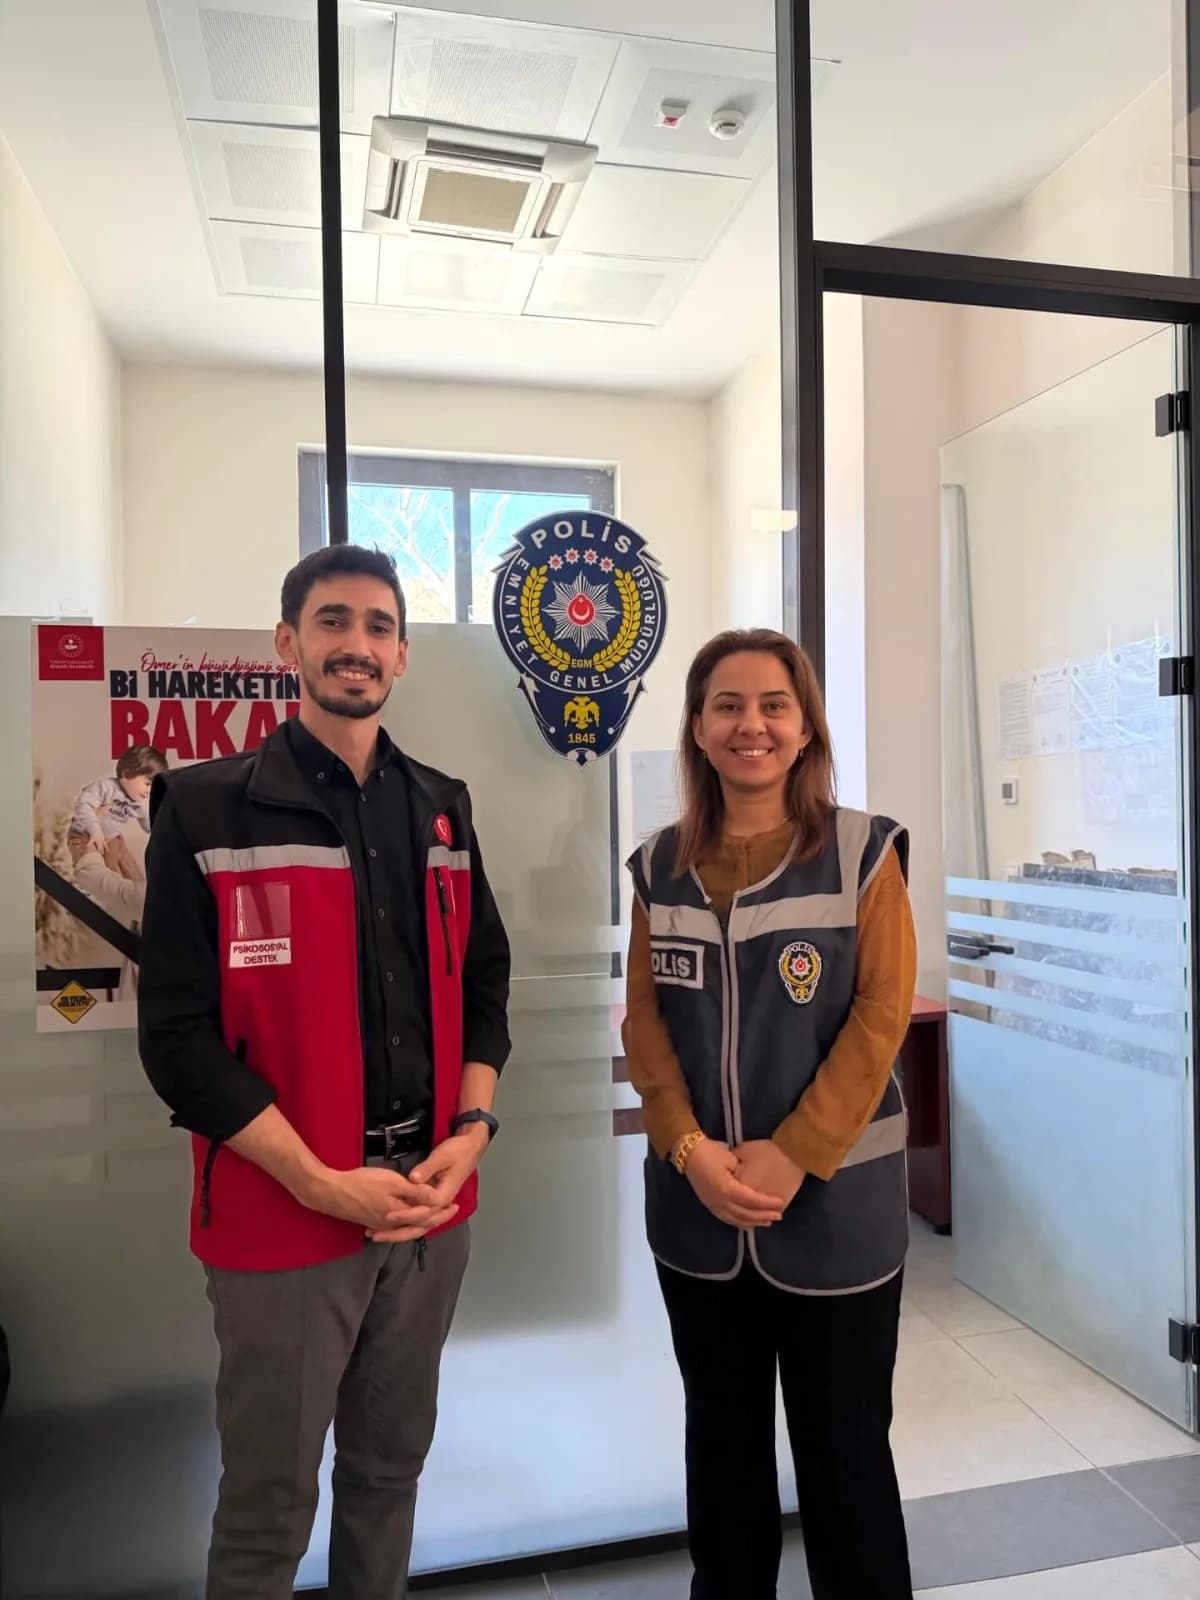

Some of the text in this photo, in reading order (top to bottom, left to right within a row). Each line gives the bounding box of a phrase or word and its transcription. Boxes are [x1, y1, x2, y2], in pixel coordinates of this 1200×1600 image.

[530, 519, 632, 554] POLİS
[550, 670, 614, 689] GENEL
[619, 563, 657, 675] MÜDÜRLÜĞÜ
[571, 658, 594, 669] EGM
[567, 732, 597, 745] 1845
[233, 943, 288, 954] PSİKOSOSYAL
[244, 954, 278, 965] DESTEK
[651, 951, 690, 978] OLİS
